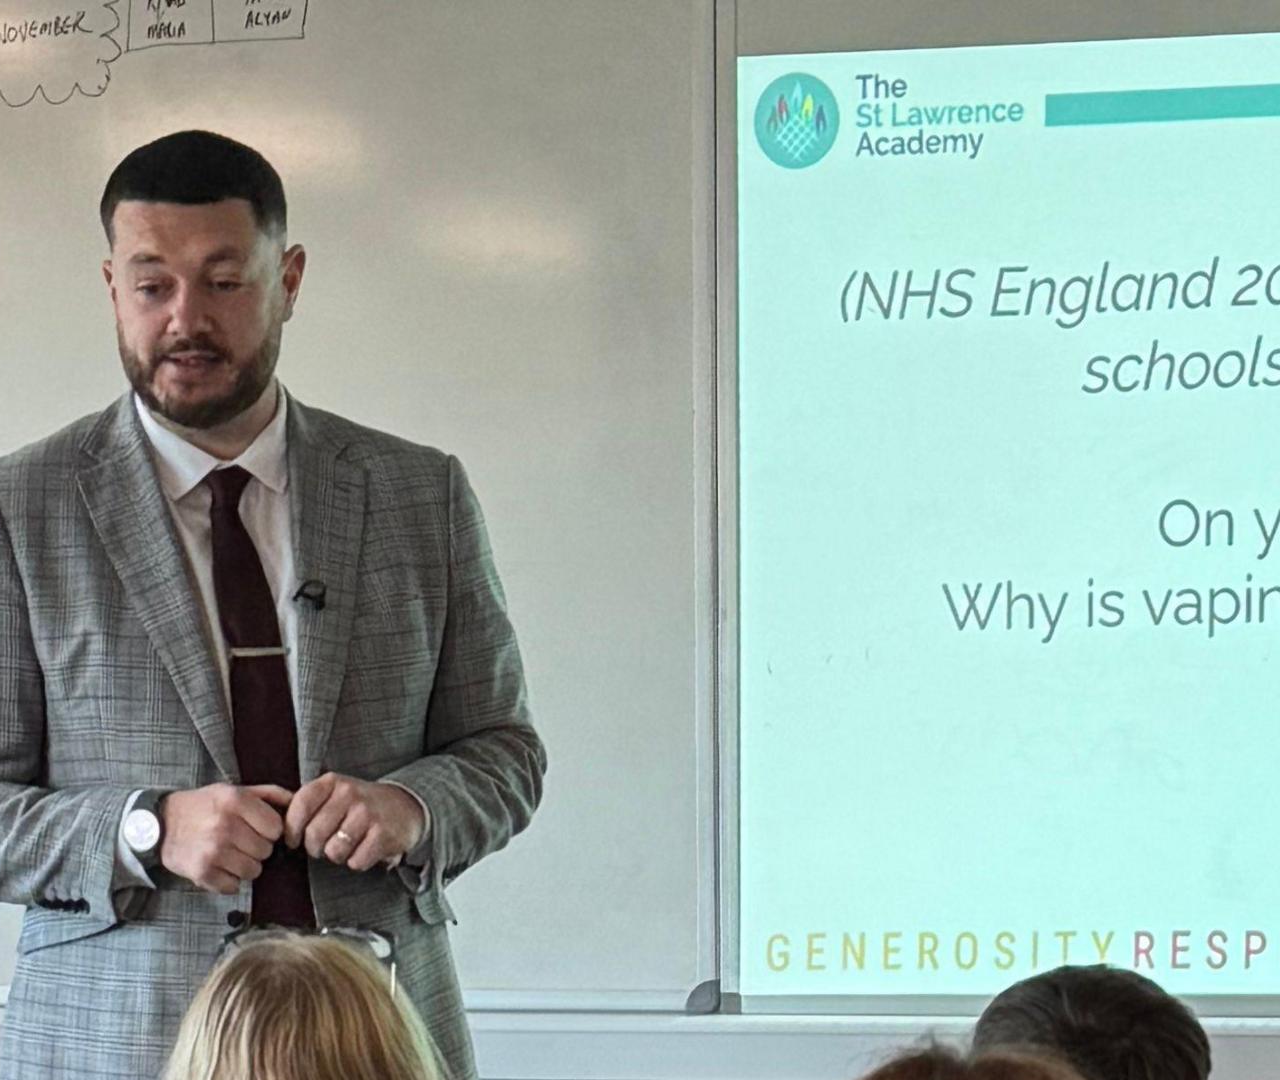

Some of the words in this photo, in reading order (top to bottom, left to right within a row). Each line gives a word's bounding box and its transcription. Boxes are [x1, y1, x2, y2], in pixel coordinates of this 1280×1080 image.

[855, 74, 907, 99] The
[856, 103, 883, 128] St
[891, 95, 1024, 127] Lawrence
[856, 126, 984, 159] Academy
[841, 269, 976, 323] (NHS
[990, 256, 1219, 329] England
[1159, 499, 1234, 547] On
[942, 580, 1068, 643] Why
[1088, 578, 1124, 627] is
[766, 931, 1115, 972] GENEROSITY
